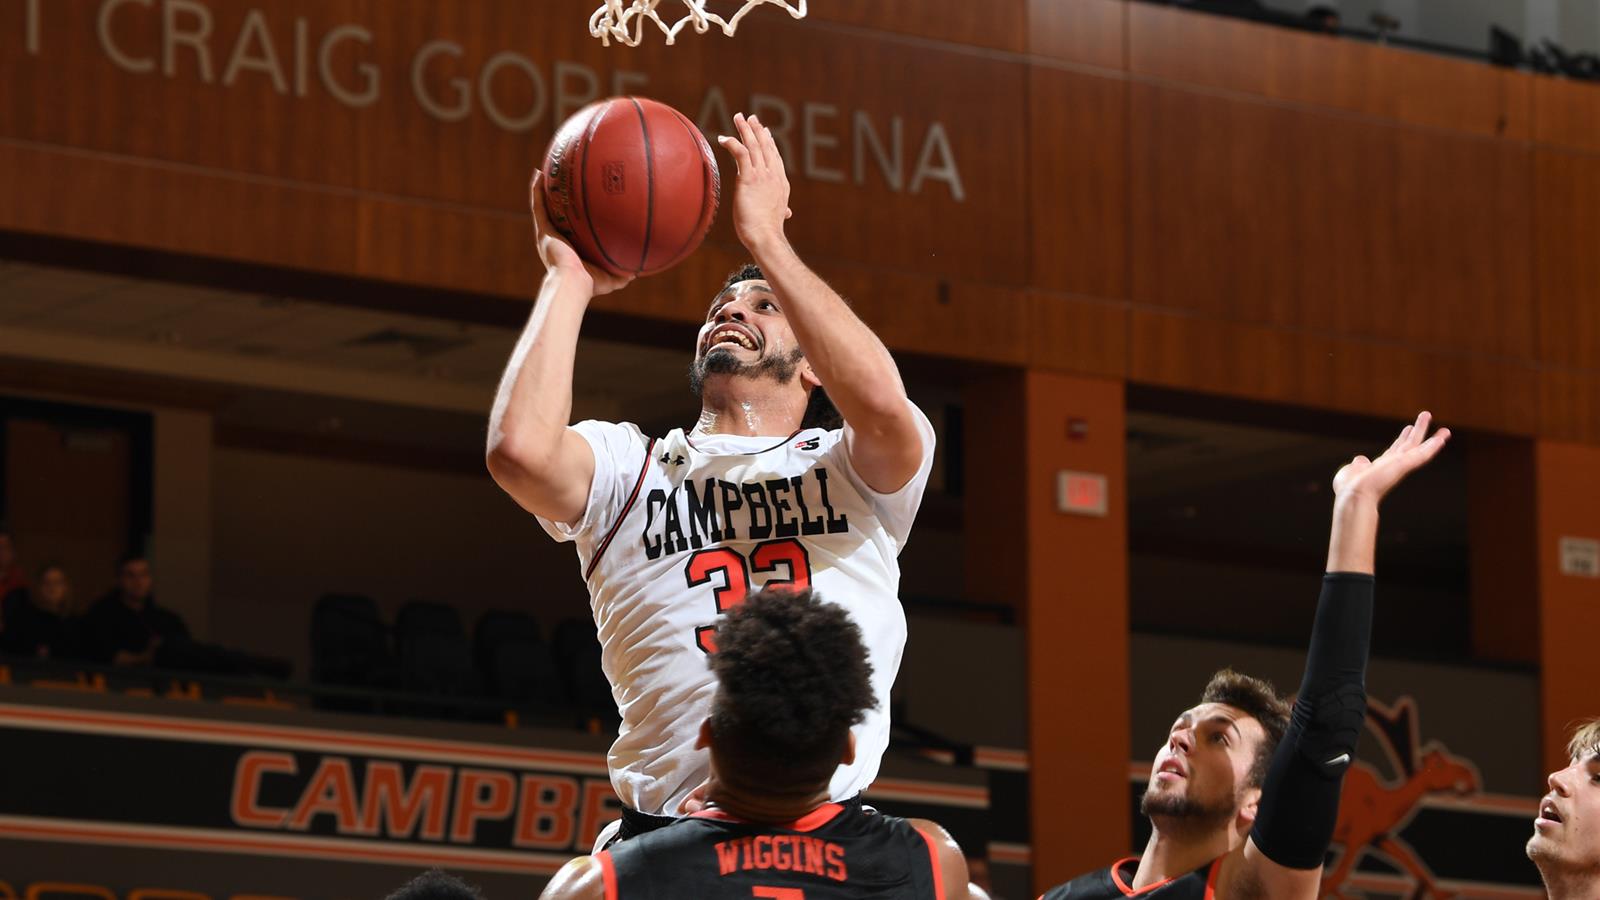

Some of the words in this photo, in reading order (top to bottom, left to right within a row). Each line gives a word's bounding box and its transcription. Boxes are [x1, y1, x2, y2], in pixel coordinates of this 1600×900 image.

[97, 0, 381, 107] CRAIG
[697, 84, 965, 201] ARENA
[642, 467, 849, 561] CAMPBELL
[714, 835, 849, 883] WIGGINS
